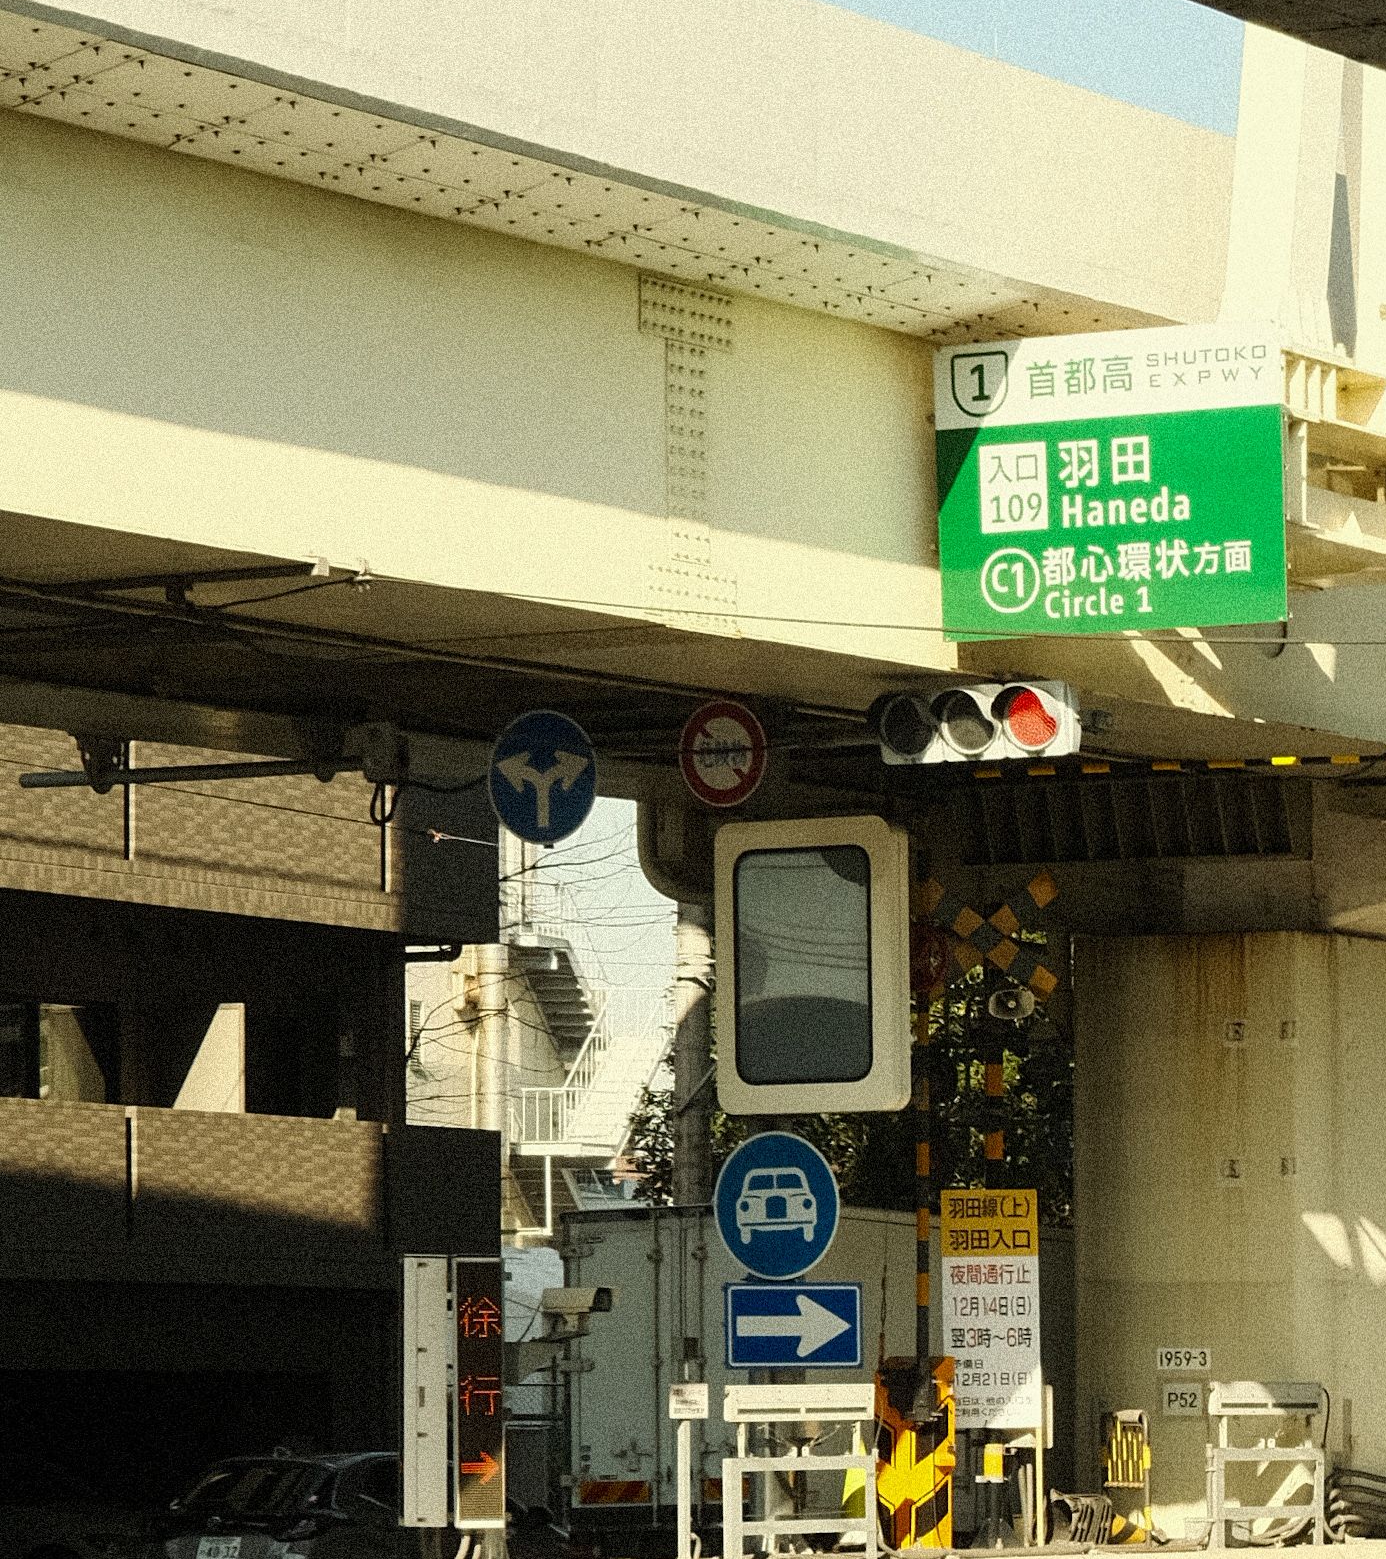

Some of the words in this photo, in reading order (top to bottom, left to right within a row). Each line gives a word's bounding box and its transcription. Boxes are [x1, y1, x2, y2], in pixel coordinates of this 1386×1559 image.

[1145, 344, 1268, 368] SHUTOKO
[969, 363, 991, 402] 1
[1025, 355, 1135, 400] 首都高
[988, 453, 1039, 485] 入口
[1057, 435, 1152, 488] 羽田
[989, 492, 1043, 525] 109
[1061, 485, 1191, 529] Haneda
[1042, 539, 1253, 587] 都心環状方面
[990, 561, 1025, 599] C1
[1044, 587, 1125, 619] Circle
[1136, 586, 1153, 614] 1
[948, 1196, 1031, 1220] 羽田線(上)
[948, 1228, 1031, 1251] 羽田入口
[949, 1263, 1031, 1286] 夜間通行止
[952, 1296, 1032, 1318] 12月14日(日)
[459, 1296, 502, 1416] 徐行
[1159, 1350, 1208, 1367] 1959-3
[1166, 1391, 1198, 1408] P52
